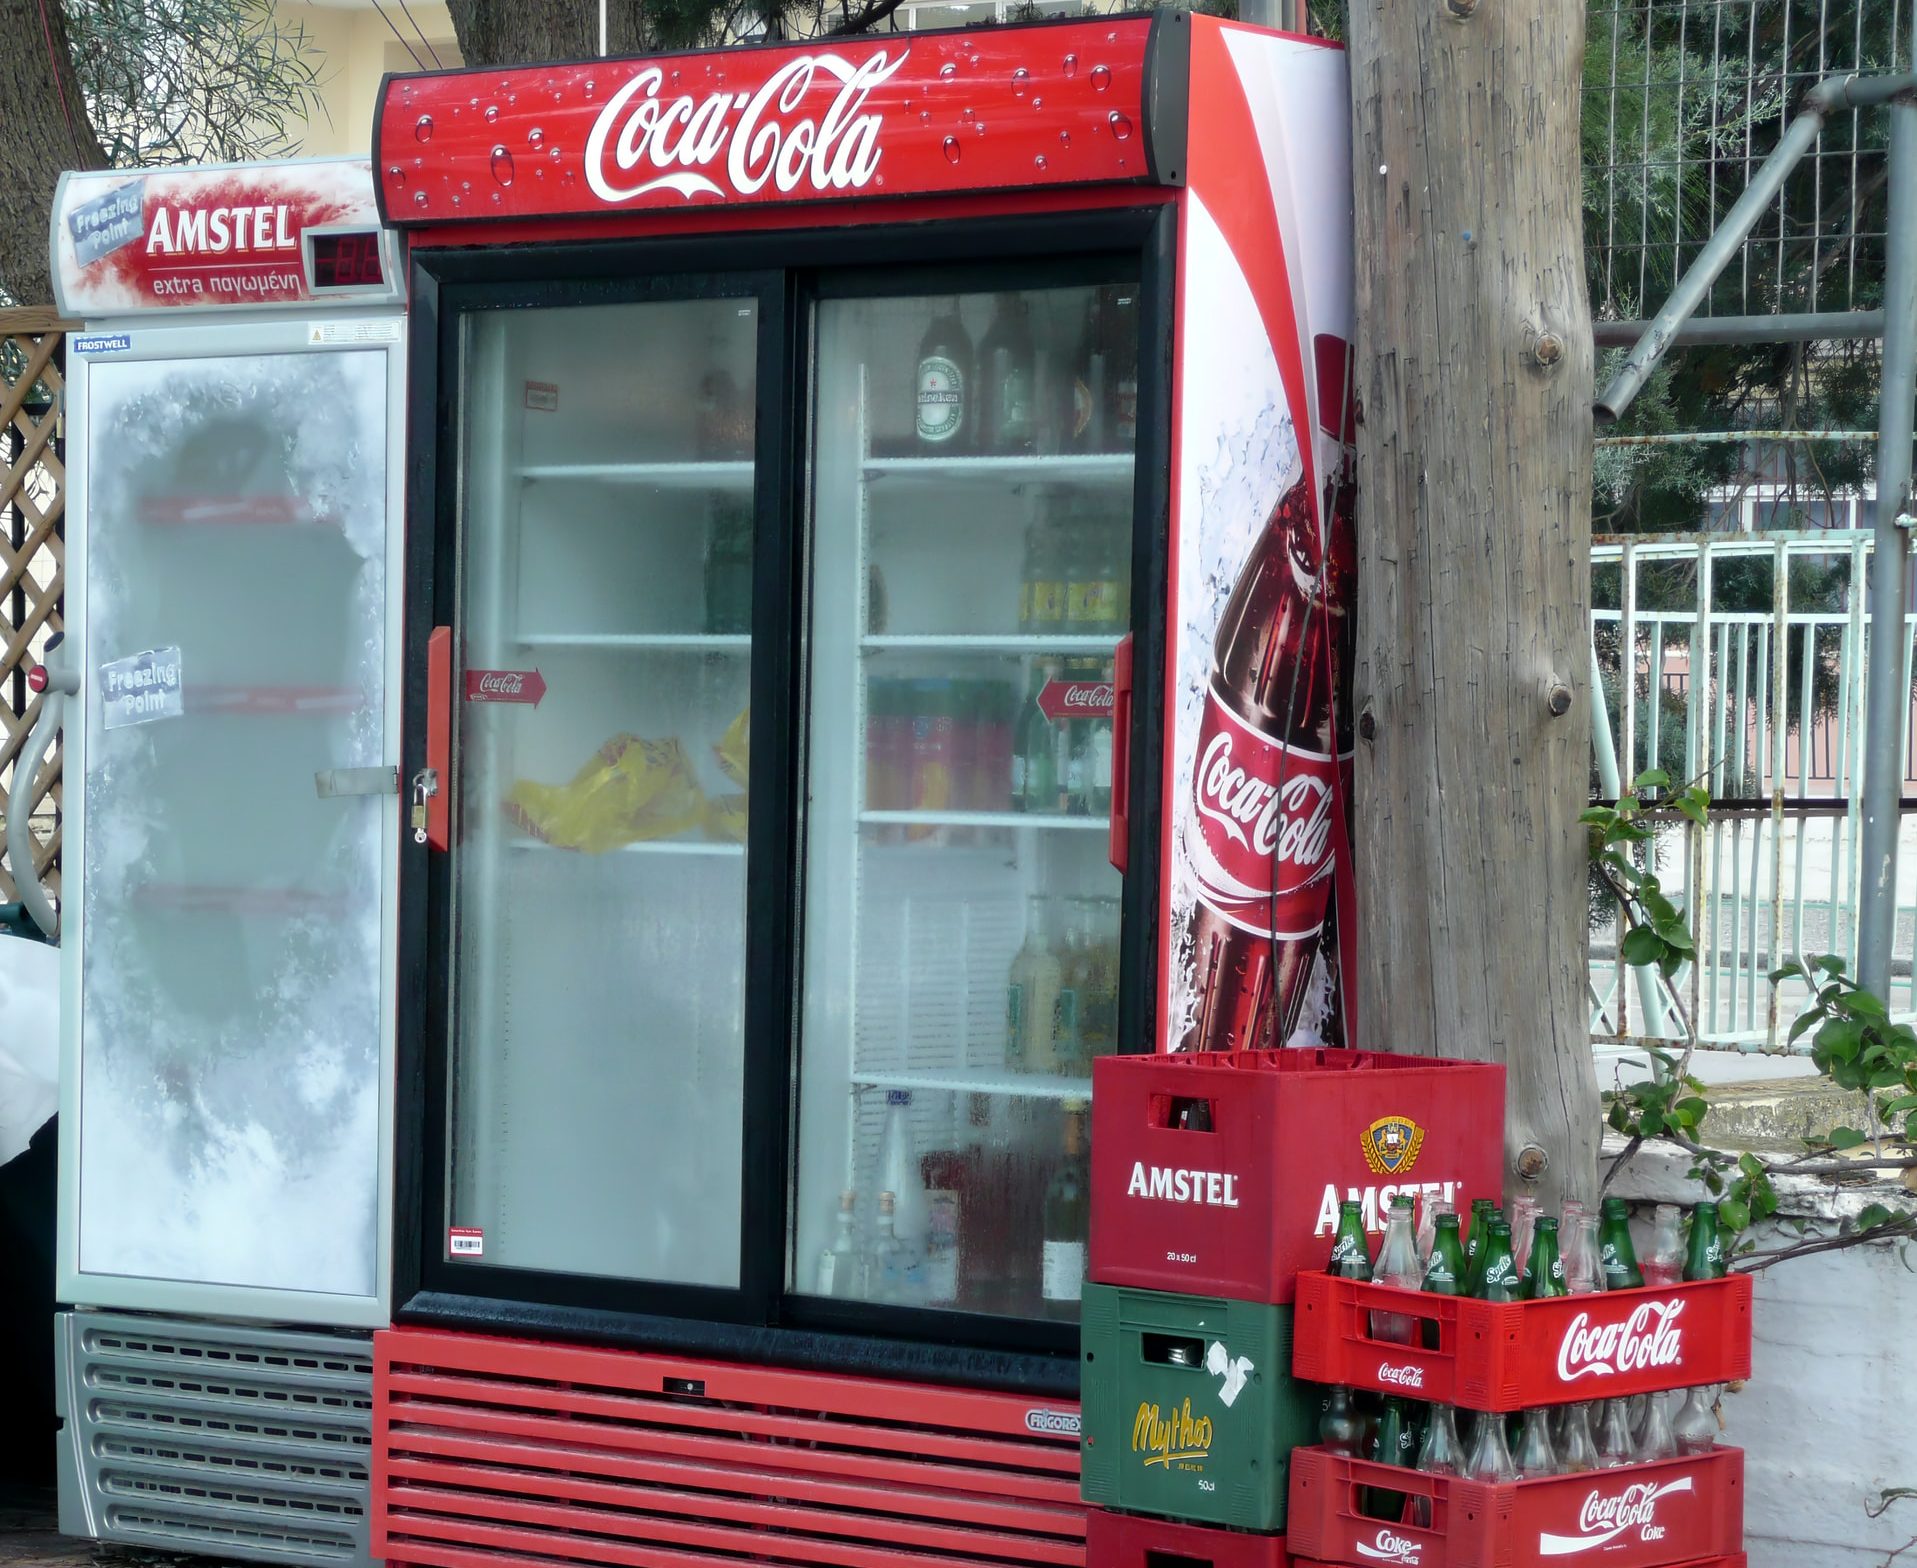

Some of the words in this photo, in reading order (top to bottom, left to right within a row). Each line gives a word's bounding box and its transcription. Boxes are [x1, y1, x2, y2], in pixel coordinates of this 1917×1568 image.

[584, 48, 911, 202] Coca-Cola
[146, 204, 297, 255] AMSTEL
[153, 276, 203, 295] extra
[210, 271, 301, 297] παγωμένη
[77, 338, 128, 350] FROSTWELL
[107, 662, 177, 692] Freezing
[1196, 731, 1333, 866] Coca-Cola
[1127, 1161, 1239, 1207] AMSTEL
[1313, 1181, 1461, 1237] AMSL
[1558, 1298, 1686, 1381] Coca-Cola
[1378, 1362, 1424, 1387] Coca-Cola
[1132, 1397, 1213, 1470] Mythos
[1579, 1482, 1659, 1532] Coca-Cola
[1375, 1529, 1412, 1554] Coke
[1640, 1523, 1666, 1541] Coke
